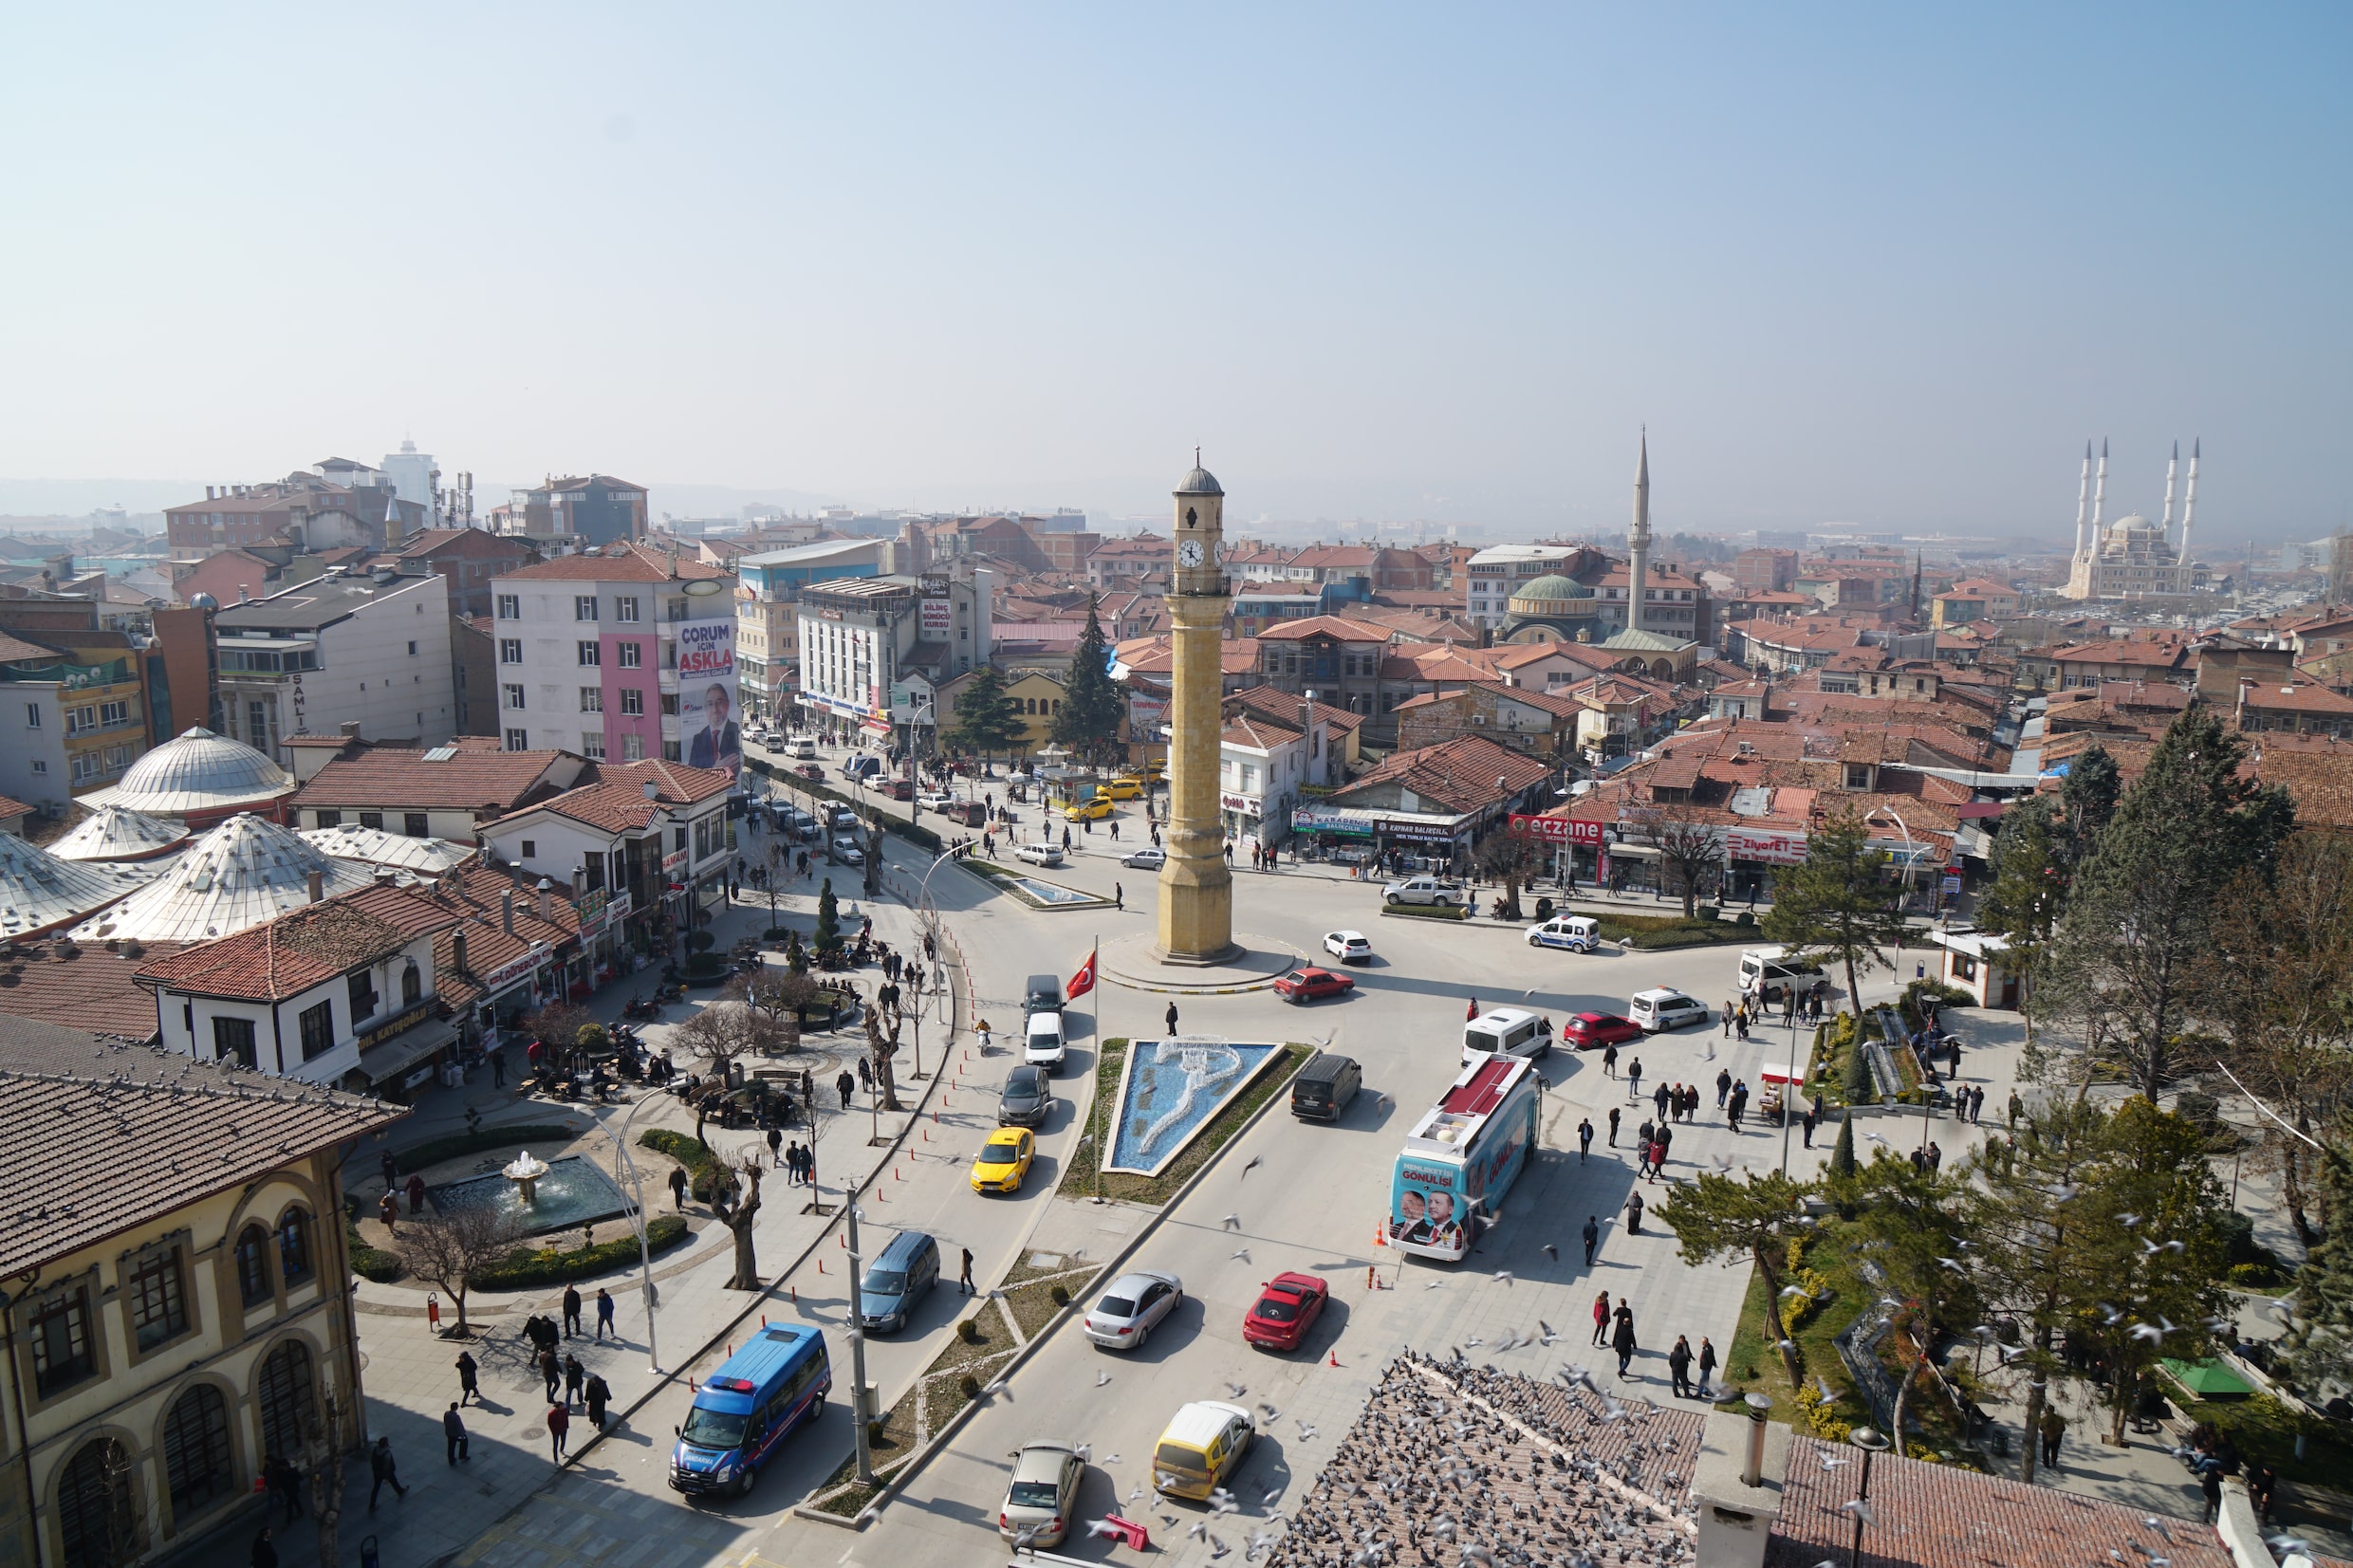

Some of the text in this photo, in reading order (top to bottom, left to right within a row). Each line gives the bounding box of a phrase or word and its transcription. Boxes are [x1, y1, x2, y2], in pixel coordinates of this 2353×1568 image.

[924, 603, 948, 612] BİLİNÇ
[682, 625, 729, 644] ÇORUM
[679, 649, 732, 671] AŞKLA
[1223, 795, 1244, 810] Optik
[1530, 820, 1598, 837] eczane
[1743, 839, 1790, 851] ZiyafET
[377, 1007, 427, 1041] KAYIŞOĞLU
[1404, 1163, 1443, 1175] MEMLEKET
[1403, 1171, 1438, 1184] GÖNÜL
[684, 1455, 713, 1465] JANDARMA
